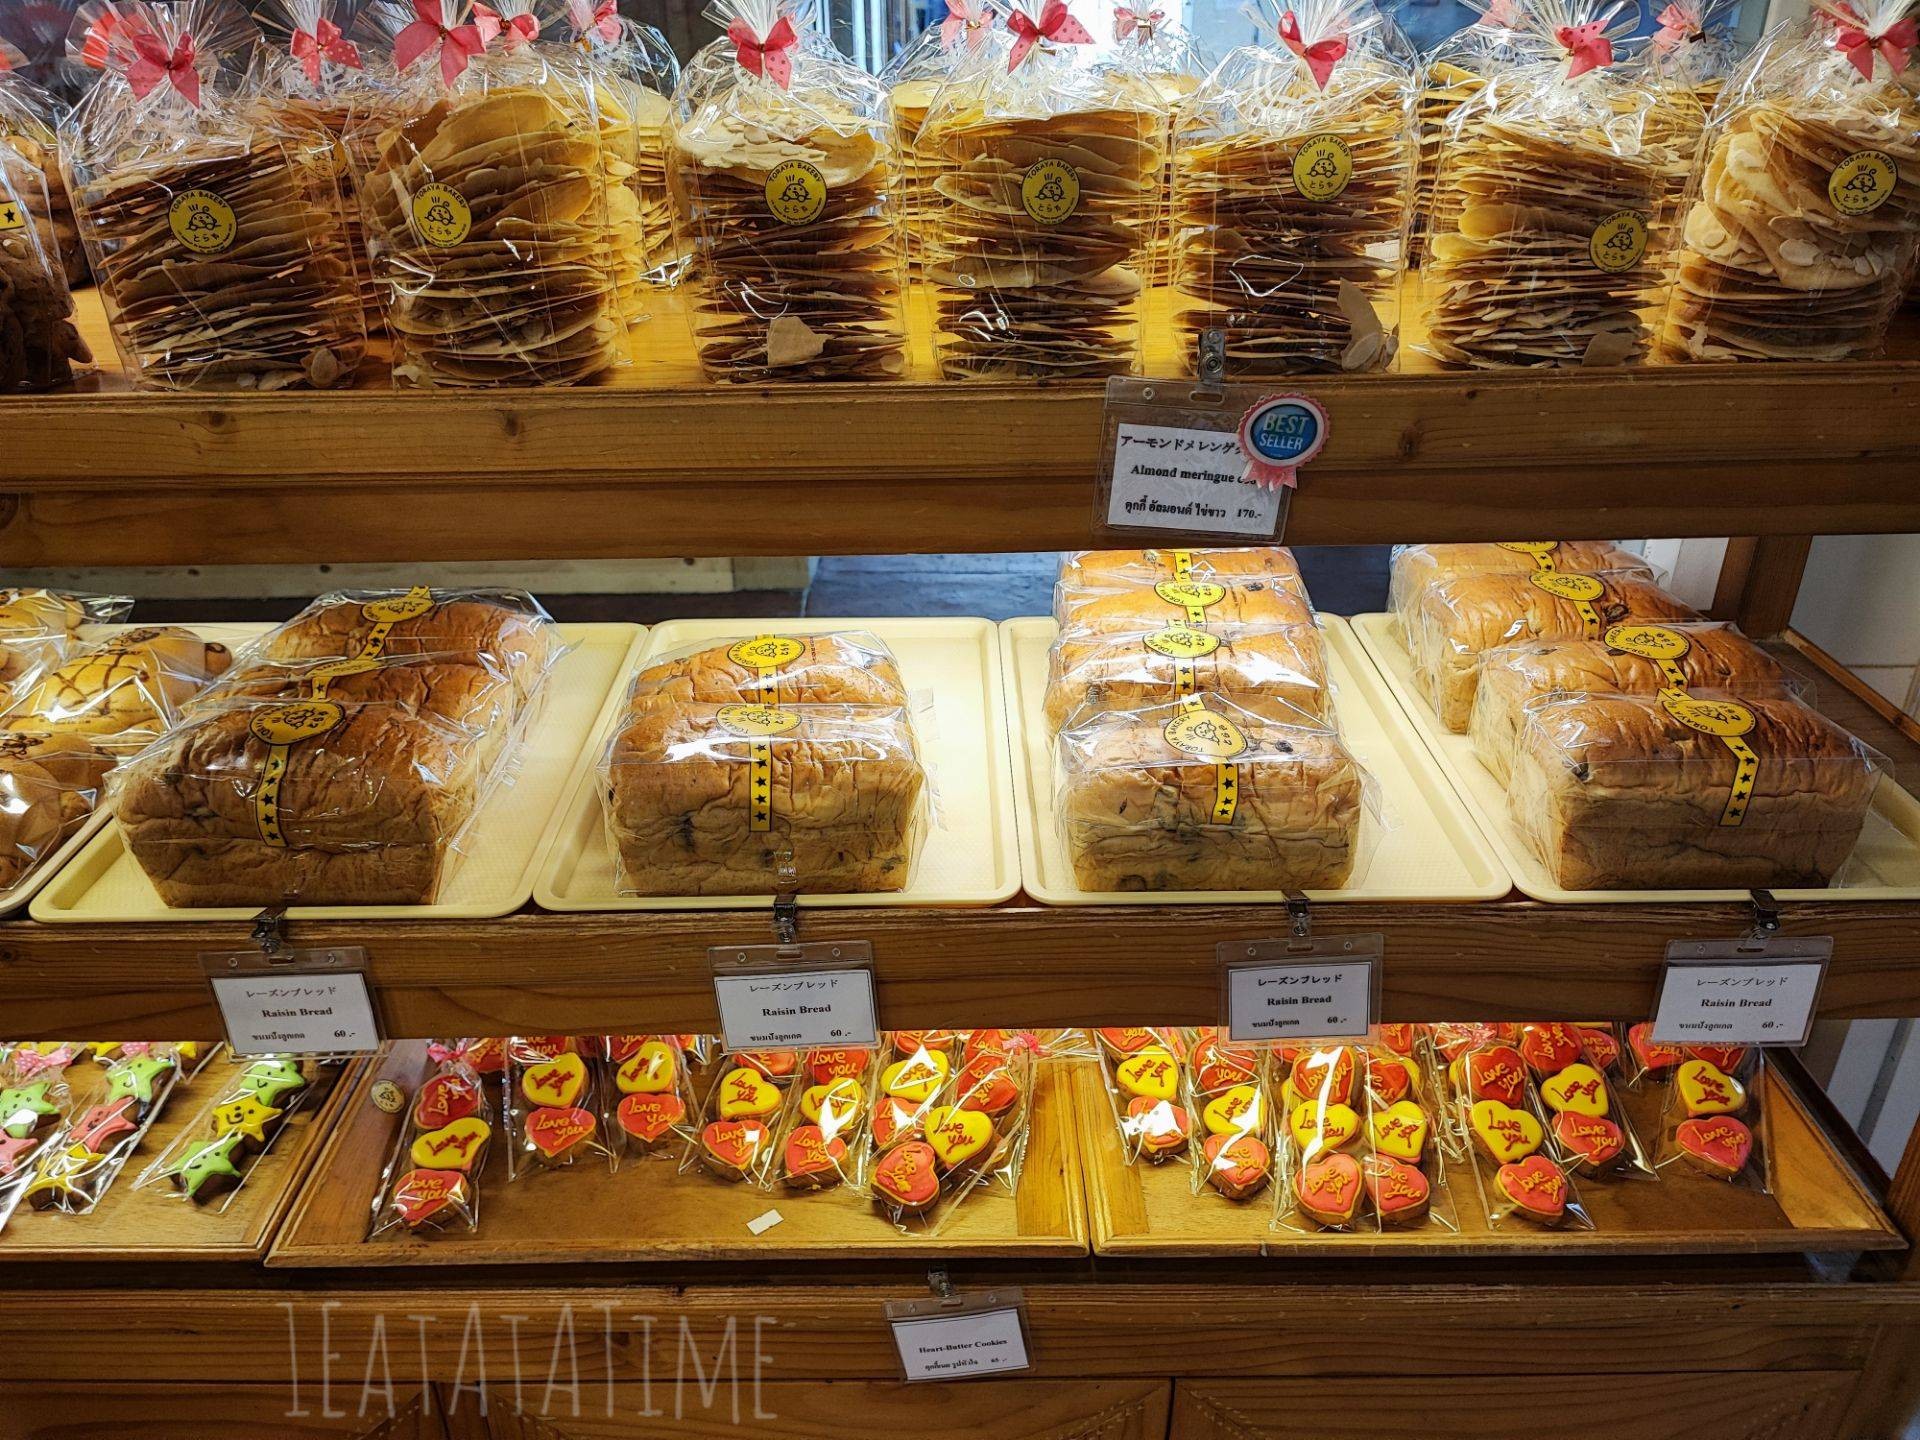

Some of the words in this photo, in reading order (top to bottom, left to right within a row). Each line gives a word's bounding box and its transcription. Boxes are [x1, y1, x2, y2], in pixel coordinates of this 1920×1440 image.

[1299, 137, 1326, 156] TORAYA
[1329, 137, 1350, 157] BAKERY
[769, 163, 794, 182] TORAYA
[797, 163, 821, 181] BAKERY
[1027, 161, 1053, 179] TORAYA
[1056, 161, 1077, 181] BAKERY
[1839, 153, 1871, 170] TORAYA
[1874, 153, 1895, 174] BAKERY
[171, 191, 195, 213] TORAYA
[199, 191, 227, 208] BAKERY
[416, 184, 440, 200] TORAYA
[443, 186, 467, 208] BAKERY
[1601, 212, 1630, 227] TORAYA
[1263, 412, 1309, 436] BEST
[1259, 432, 1304, 451] SELLER
[1131, 464, 1177, 479] Almond
[1181, 469, 1235, 484] meringue
[1125, 495, 1148, 514] คุกกี้
[1149, 499, 1193, 515] อัลมอนด์
[1195, 503, 1226, 517] ไข่ขาว
[1168, 715, 1191, 736] BAKERY
[1675, 711, 1716, 733] TORAYA
[1171, 736, 1205, 753] TORAYA
[762, 1008, 796, 1016] Raisin
[800, 1004, 831, 1014] Bread
[1267, 997, 1298, 1006] Raisin
[1302, 995, 1332, 1004] Bread
[1701, 999, 1736, 1007] Raisin
[1739, 998, 1773, 1007] Bread
[262, 1008, 297, 1018] Raisin
[300, 1007, 333, 1016] Bread
[919, 1343, 973, 1354] Heart-Butter
[974, 1338, 1008, 1348] Cookies
